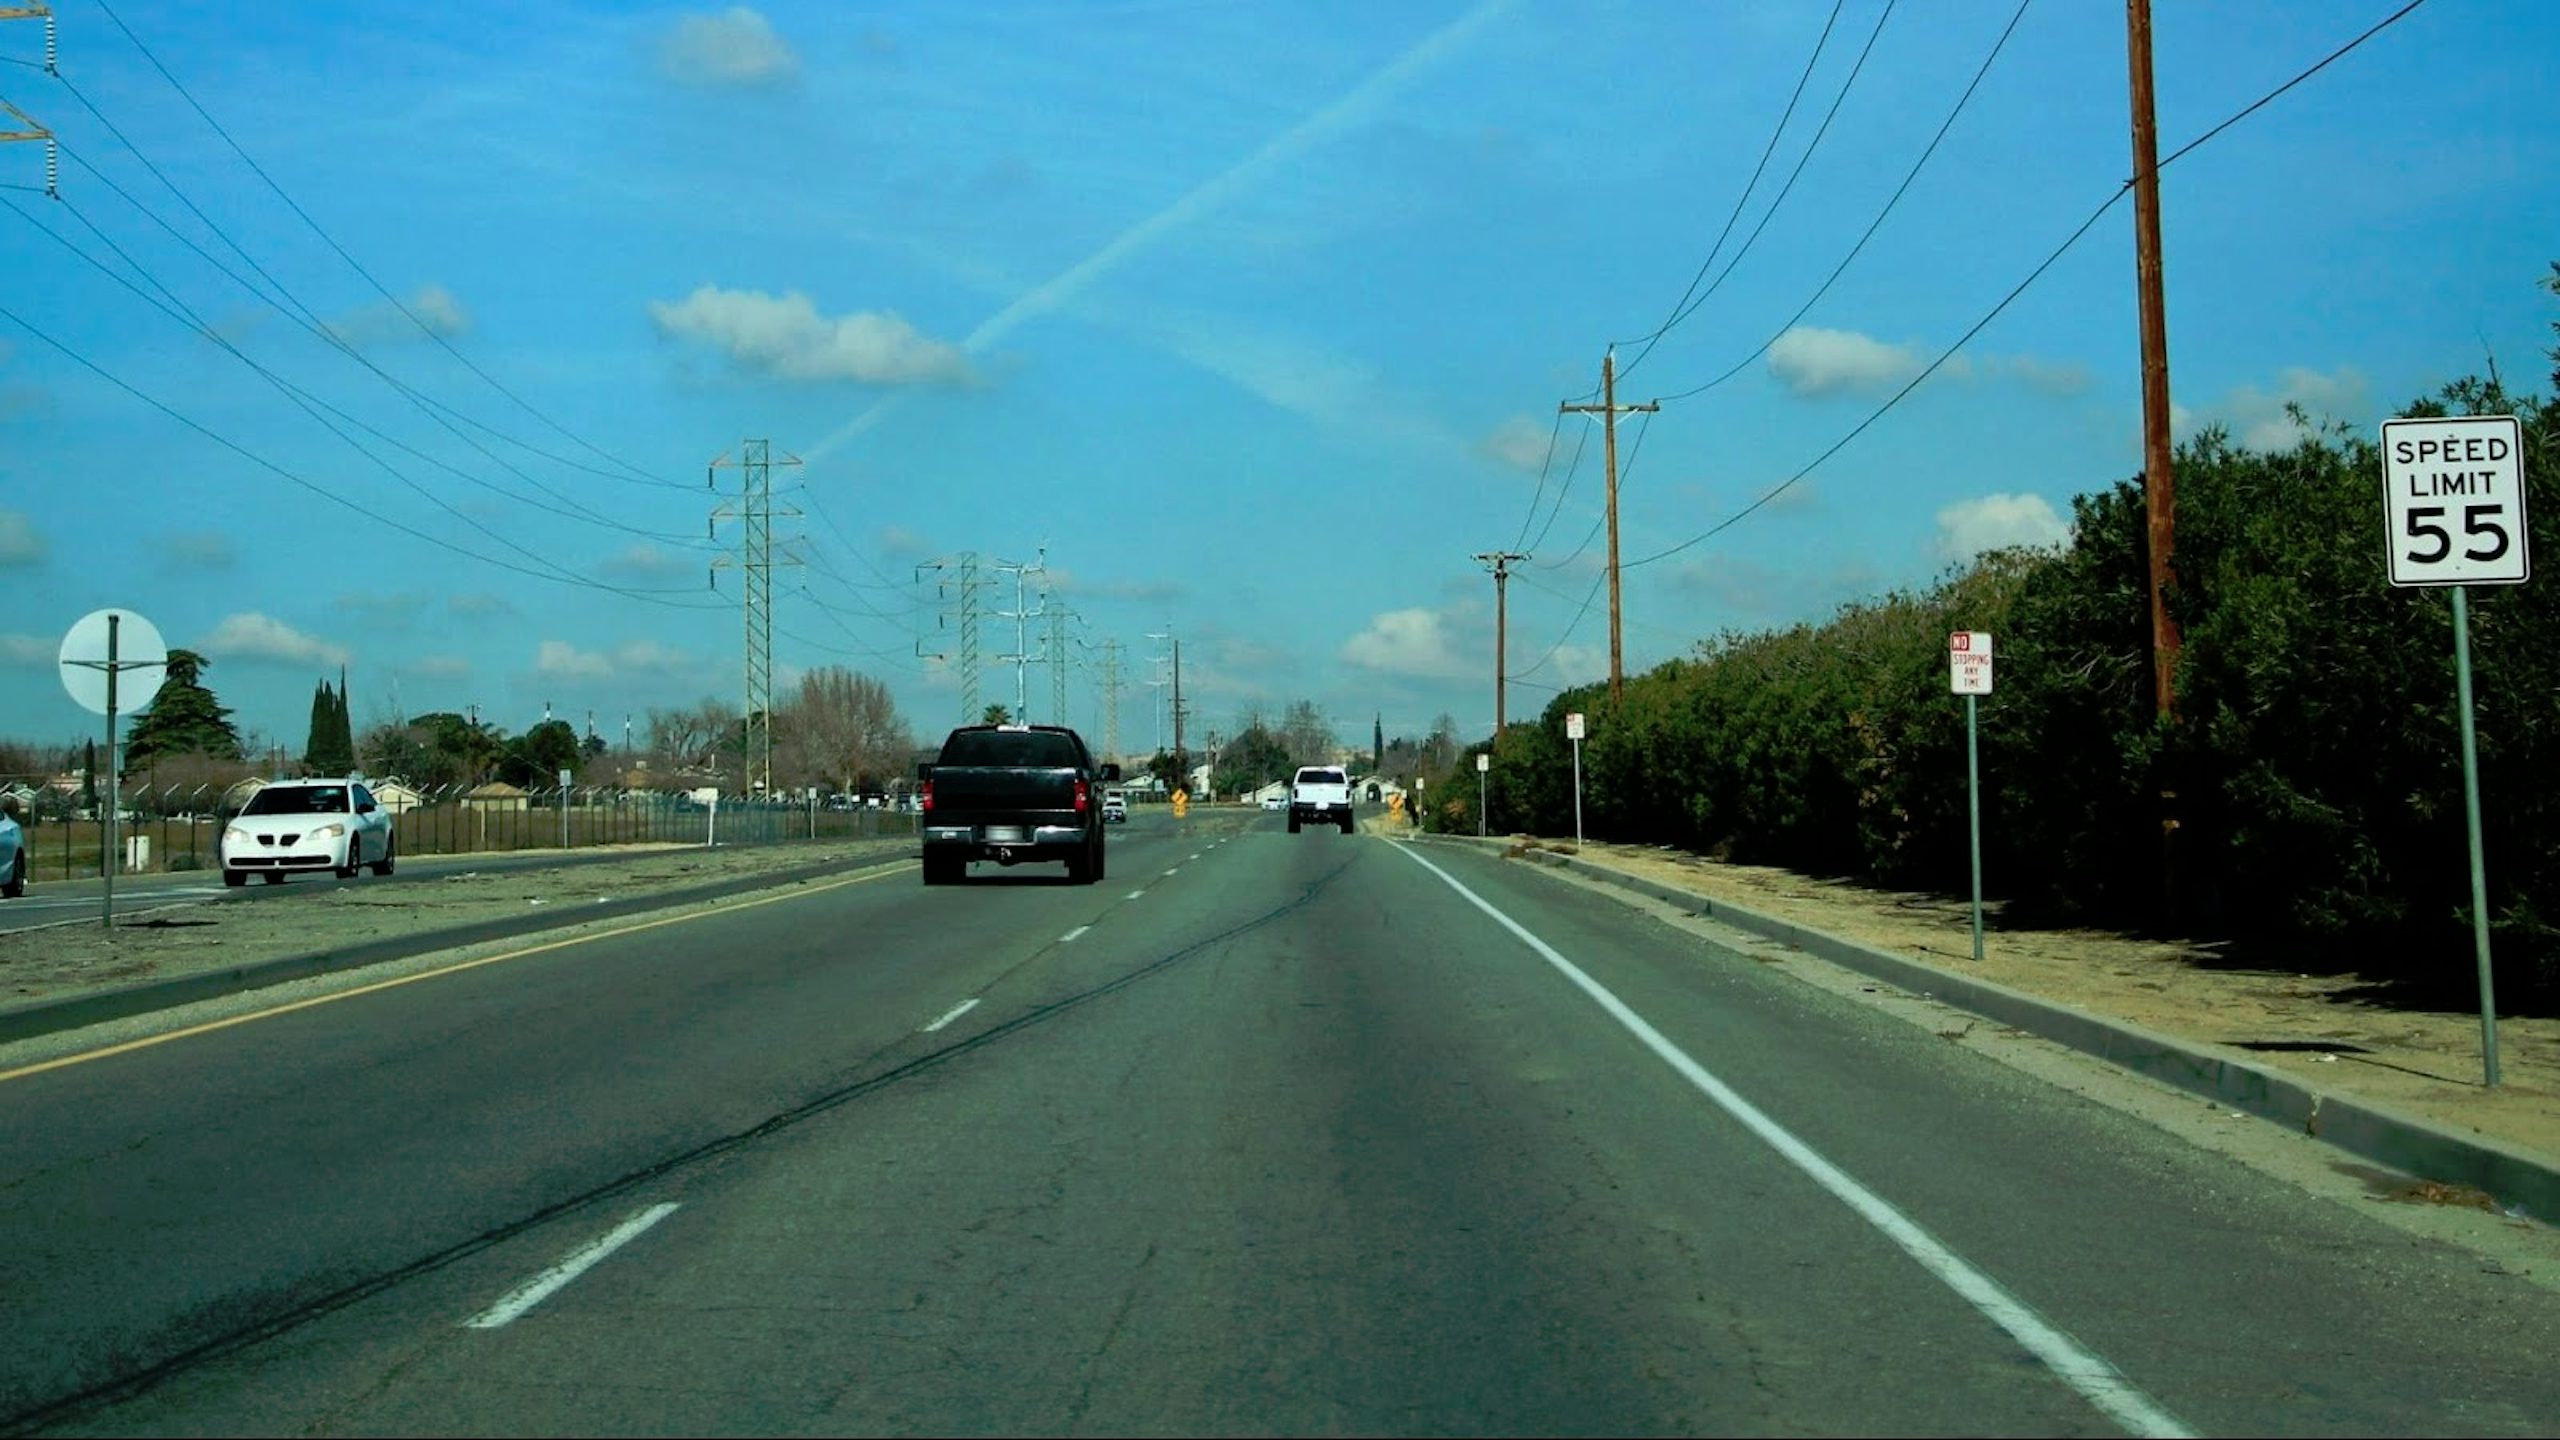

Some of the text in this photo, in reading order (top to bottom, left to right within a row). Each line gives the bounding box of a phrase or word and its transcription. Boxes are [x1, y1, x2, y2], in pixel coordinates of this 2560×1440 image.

[2396, 438, 2508, 464] SPEED
[2410, 472, 2496, 496] LIMIT
[2407, 504, 2509, 564] 55
[1952, 635, 1968, 650] NO
